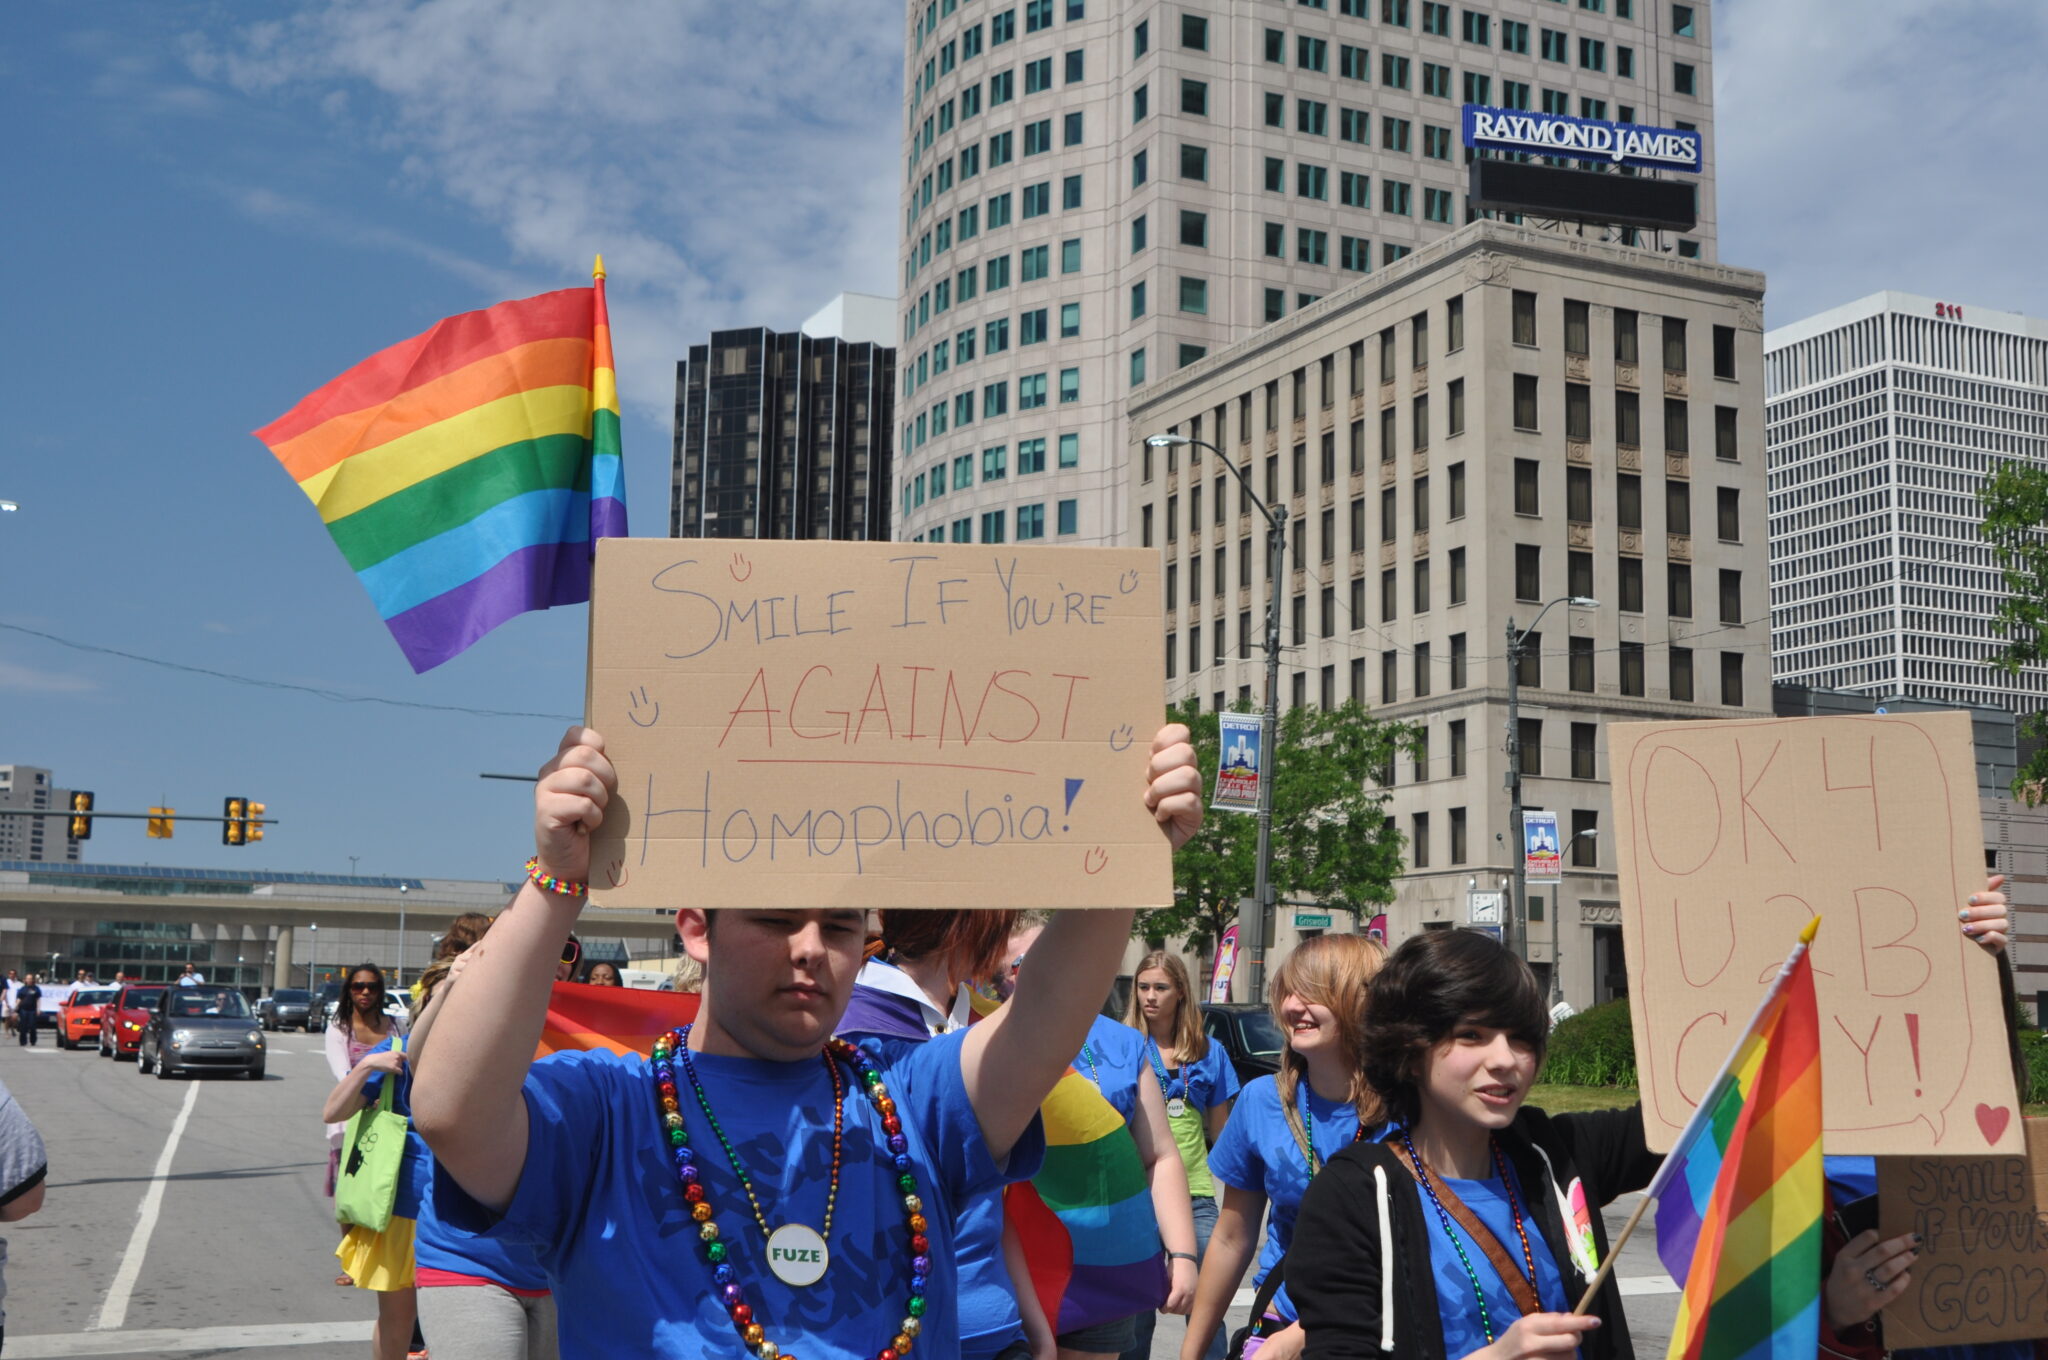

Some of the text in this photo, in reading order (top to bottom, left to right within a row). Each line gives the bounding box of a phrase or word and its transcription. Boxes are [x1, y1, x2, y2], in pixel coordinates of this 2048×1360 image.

[1473, 112, 1697, 162] RAYMOND JAMES
[1935, 301, 1963, 319] 211
[652, 559, 855, 659] SMILE
[889, 555, 970, 628] IF
[718, 663, 1091, 749] AGAINST
[1222, 722, 1259, 731] DETROIT
[1298, 916, 1329, 927] Griswold
[1907, 1156, 2025, 1206] SMILE
[772, 1247, 821, 1263] FUZE
[1914, 1206, 1946, 1256] IF
